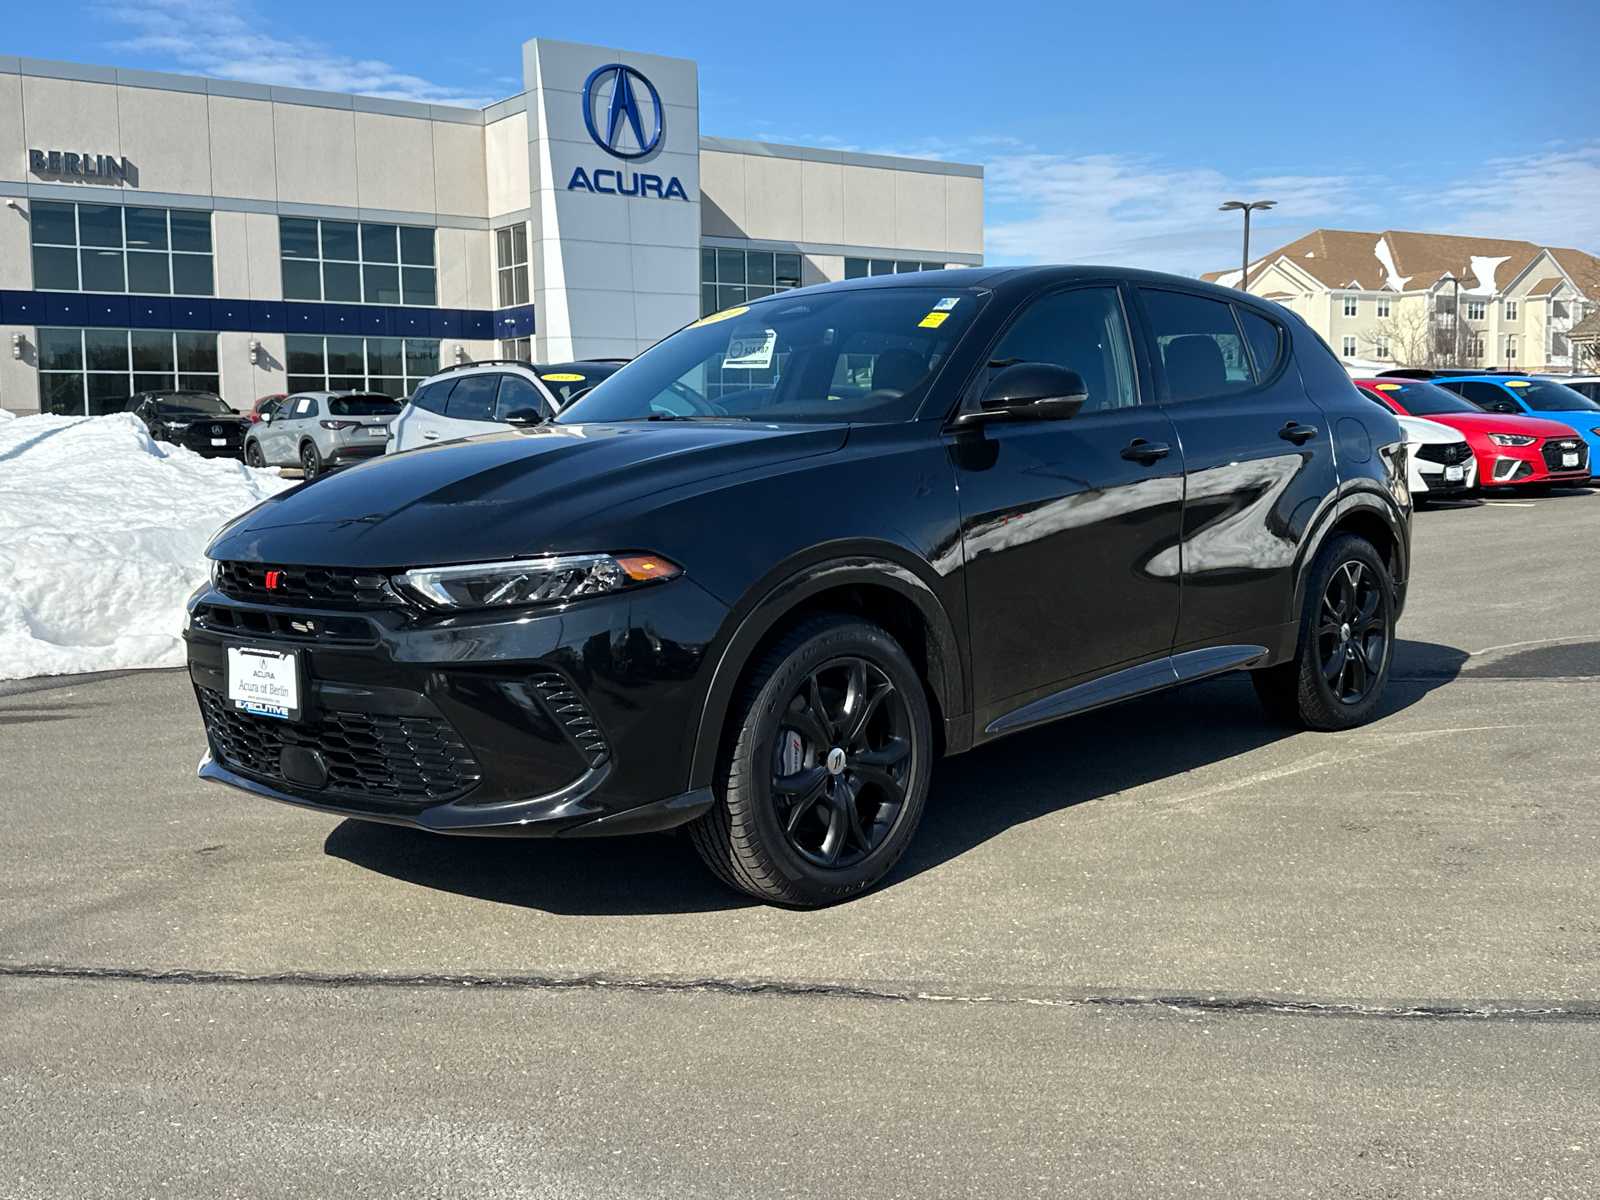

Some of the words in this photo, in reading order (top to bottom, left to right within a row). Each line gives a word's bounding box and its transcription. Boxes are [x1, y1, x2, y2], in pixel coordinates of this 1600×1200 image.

[29, 149, 127, 178] BERLIN
[567, 166, 690, 202] ACURA
[253, 670, 275, 679] ACURA
[239, 679, 259, 692] Acura
[260, 684, 267, 694] of
[269, 683, 289, 697] Berlin
[235, 700, 288, 716] EXECUTIVE
